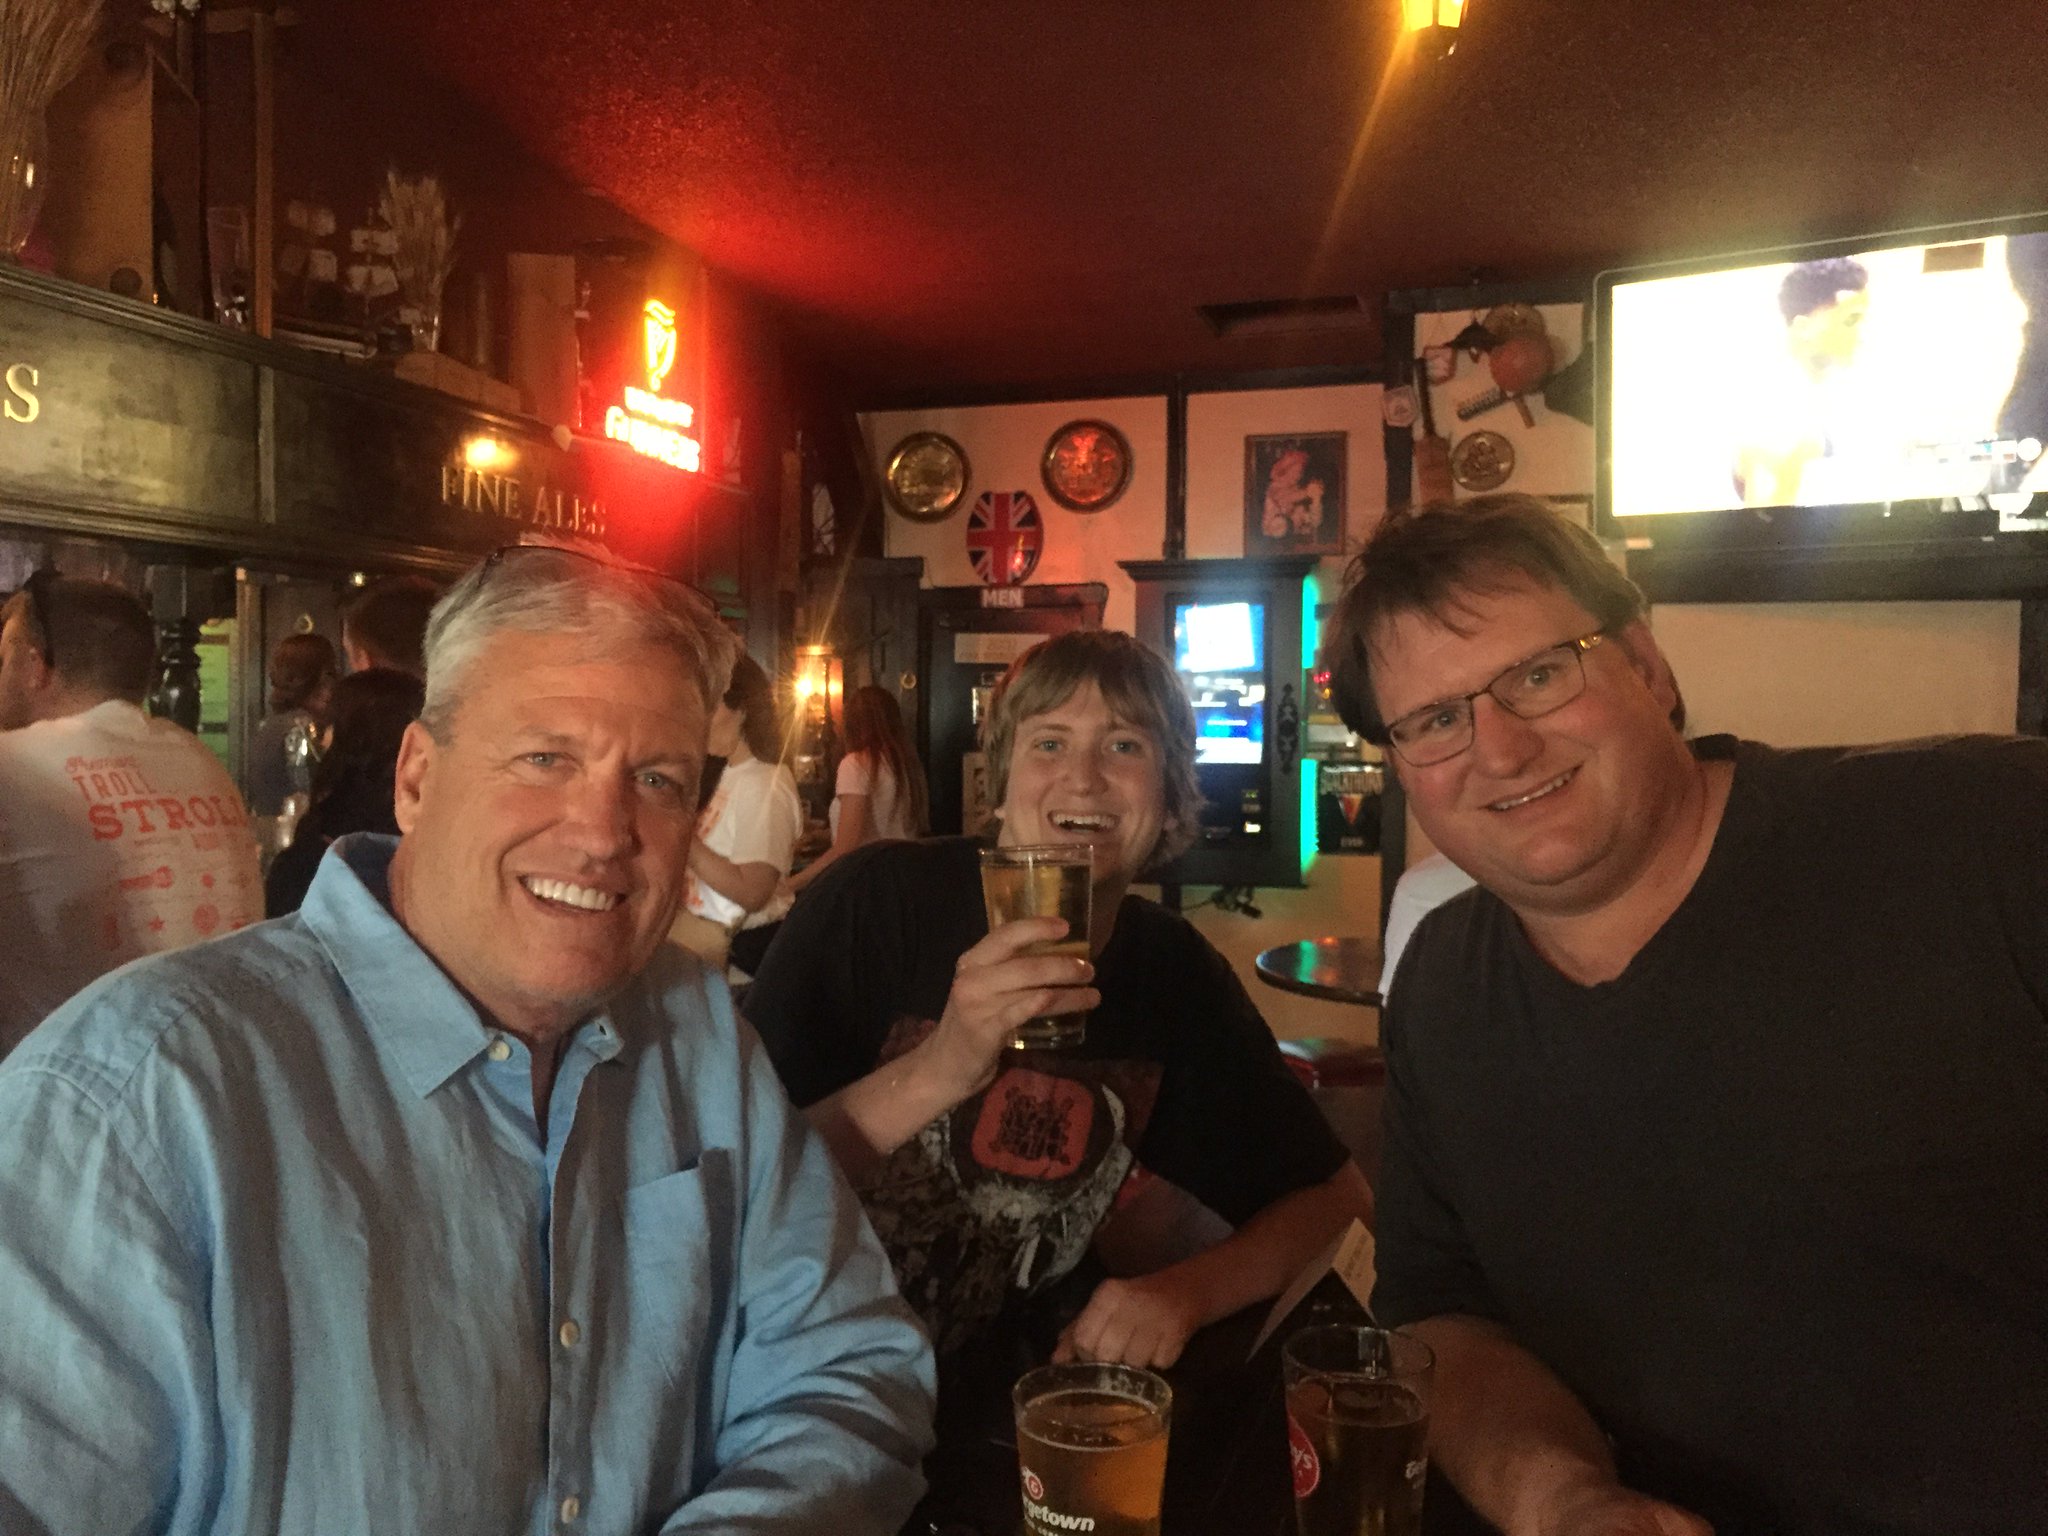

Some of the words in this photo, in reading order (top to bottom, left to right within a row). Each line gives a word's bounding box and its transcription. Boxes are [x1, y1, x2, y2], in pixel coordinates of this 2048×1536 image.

[441, 466, 522, 519] FINE
[532, 486, 607, 534] ALES
[982, 588, 1024, 607] MEN
[73, 770, 157, 801] TROLL
